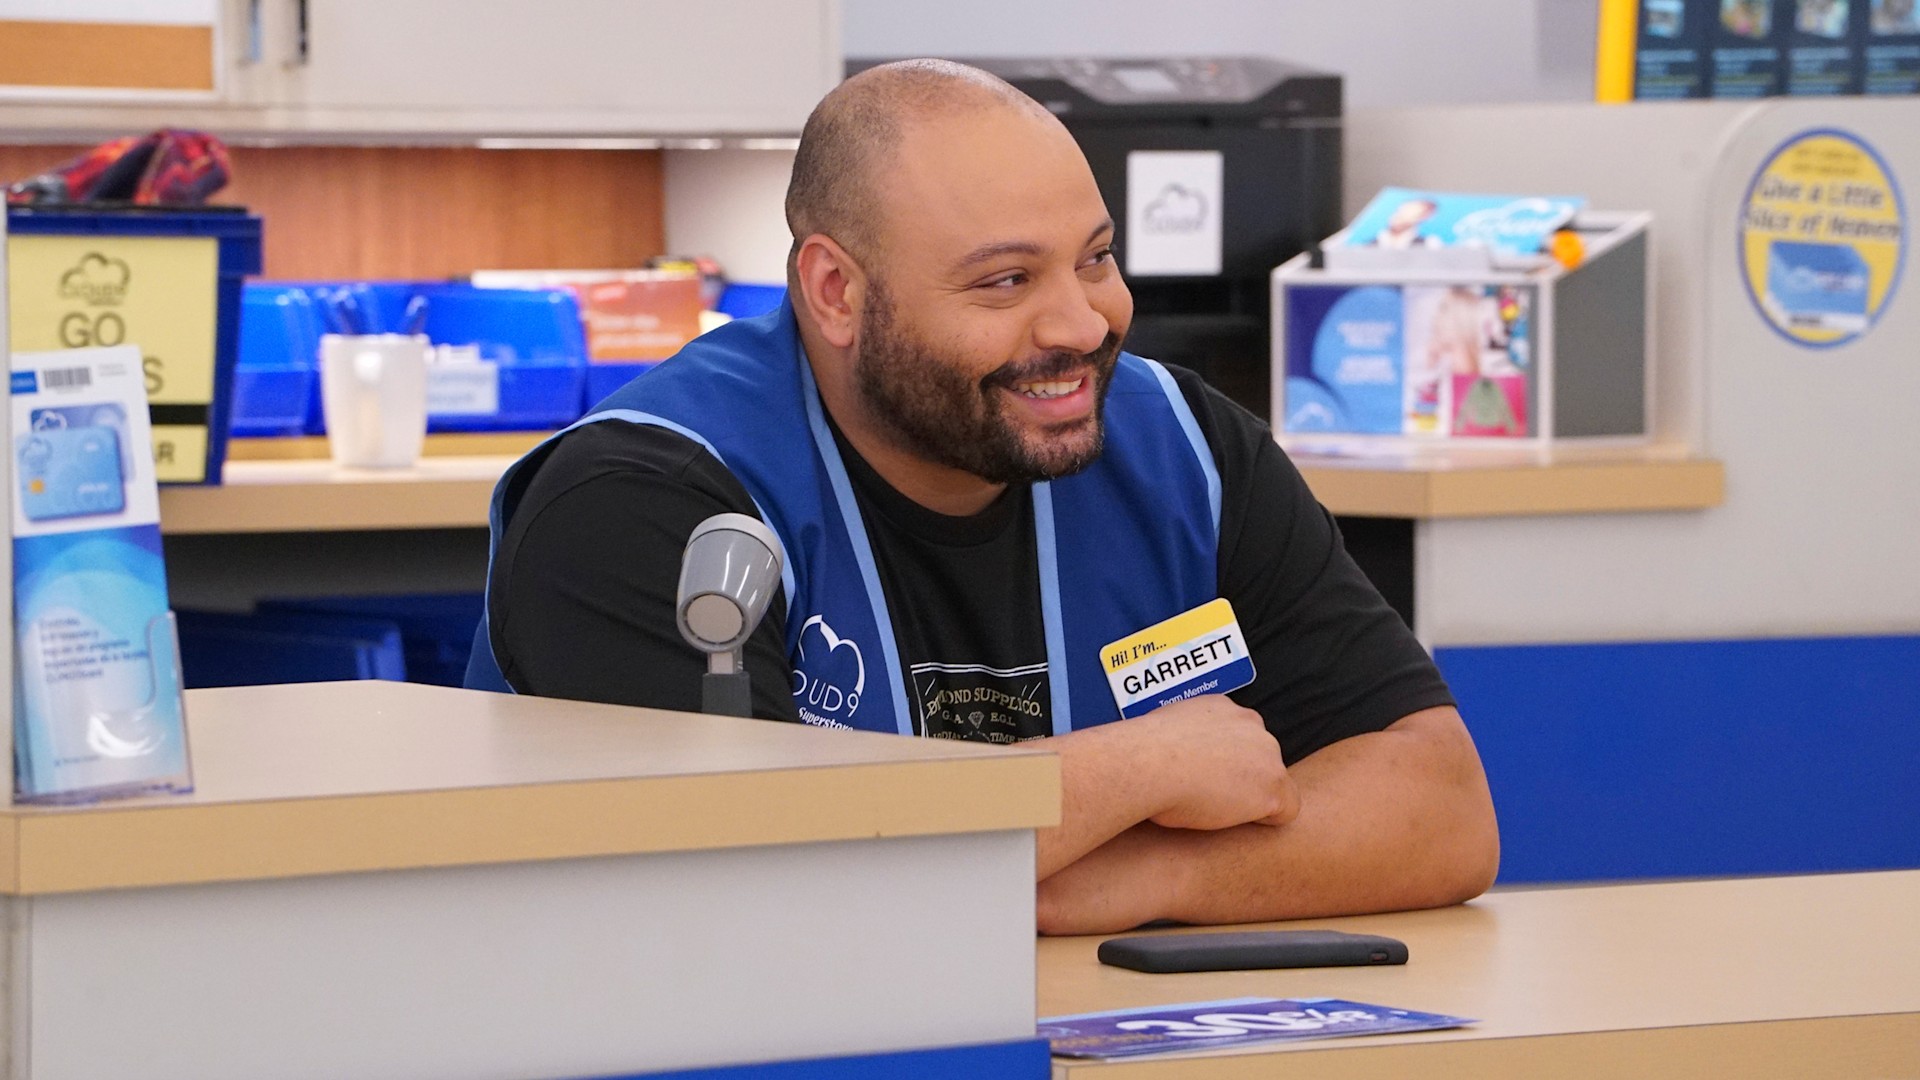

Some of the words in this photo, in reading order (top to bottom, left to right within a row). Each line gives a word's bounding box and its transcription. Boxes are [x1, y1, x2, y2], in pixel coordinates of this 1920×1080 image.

[59, 311, 126, 348] GO
[1110, 650, 1129, 668] Hi!
[1123, 634, 1232, 695] GARRETT
[1159, 694, 1184, 707] Team
[1183, 679, 1219, 699] Member
